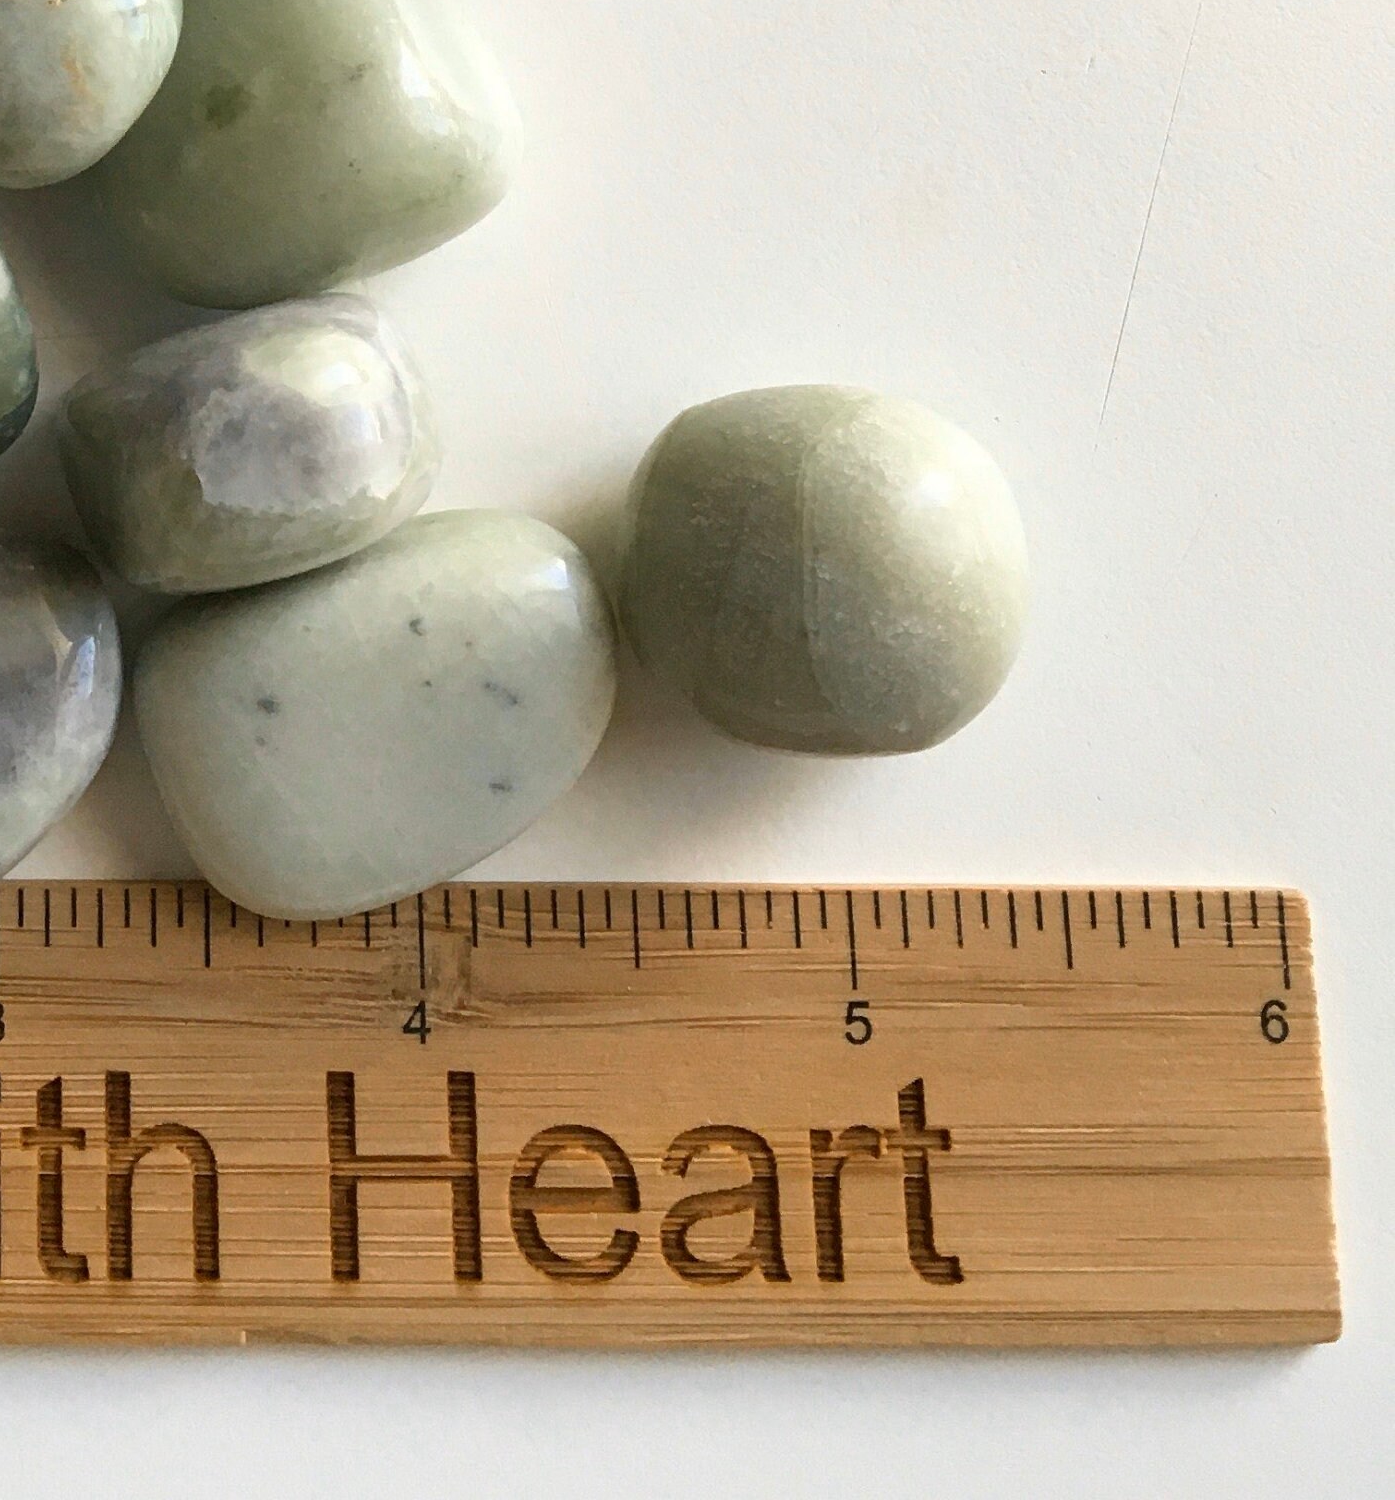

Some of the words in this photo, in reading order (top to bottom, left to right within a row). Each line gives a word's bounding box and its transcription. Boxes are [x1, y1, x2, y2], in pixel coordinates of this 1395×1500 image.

[402, 1000, 433, 1045] 4
[844, 1000, 873, 1046] 5
[1259, 999, 1290, 1045] 6
[325, 1069, 967, 1287] Heart
